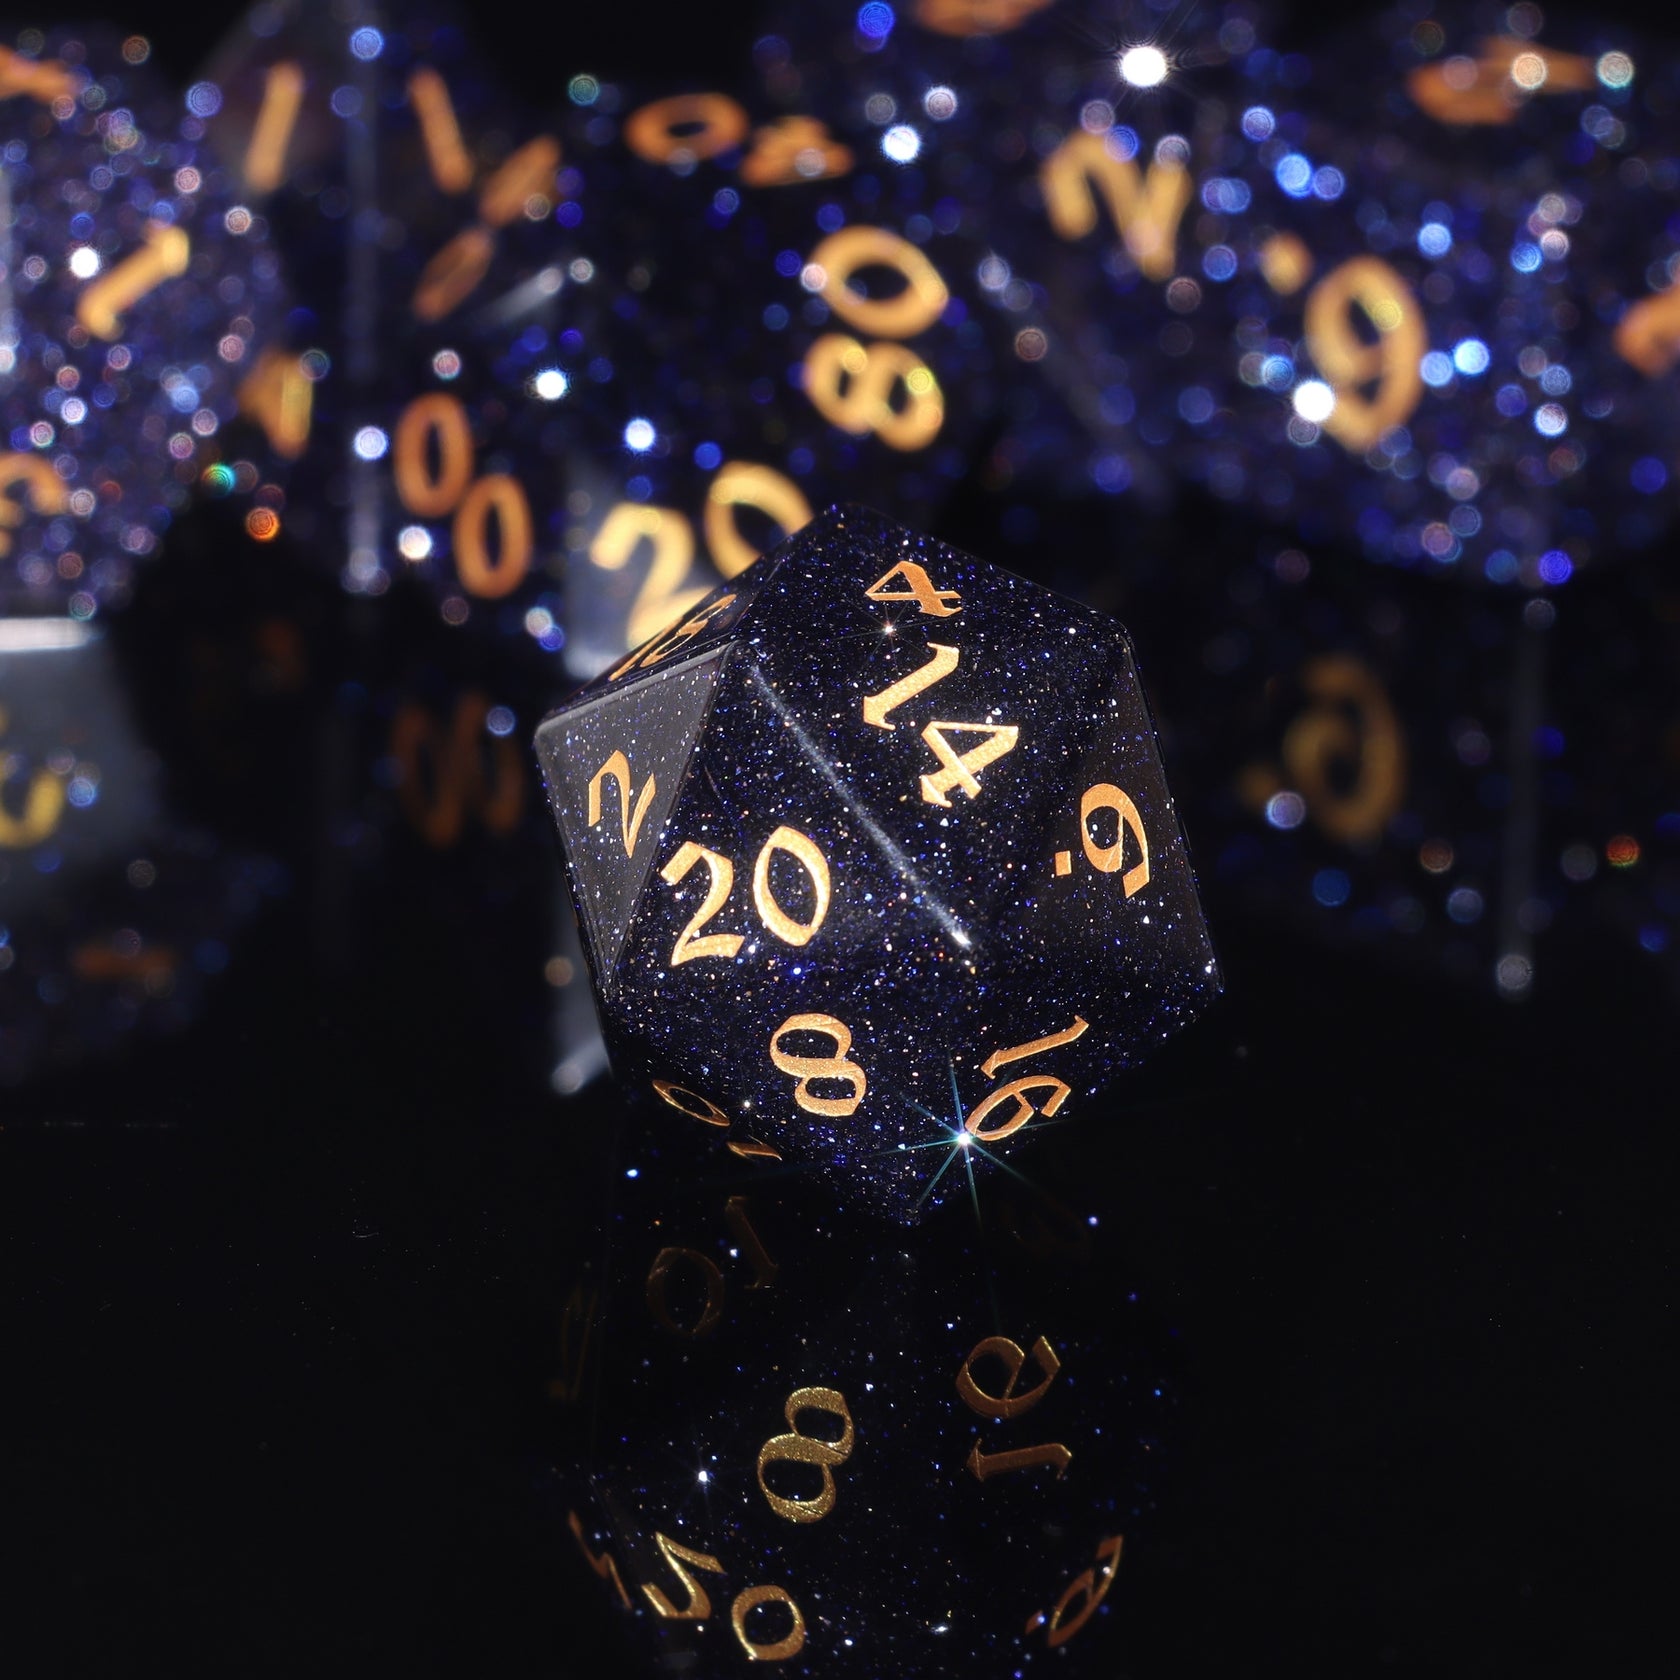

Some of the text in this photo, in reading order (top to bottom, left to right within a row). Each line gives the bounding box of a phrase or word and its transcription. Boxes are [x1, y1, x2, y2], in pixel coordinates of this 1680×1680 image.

[865, 559, 963, 618] 4
[861, 641, 1019, 808] 14
[587, 749, 658, 858] 2
[659, 823, 832, 966] 20
[768, 1011, 868, 1117] 8
[964, 1014, 1089, 1142] 16
